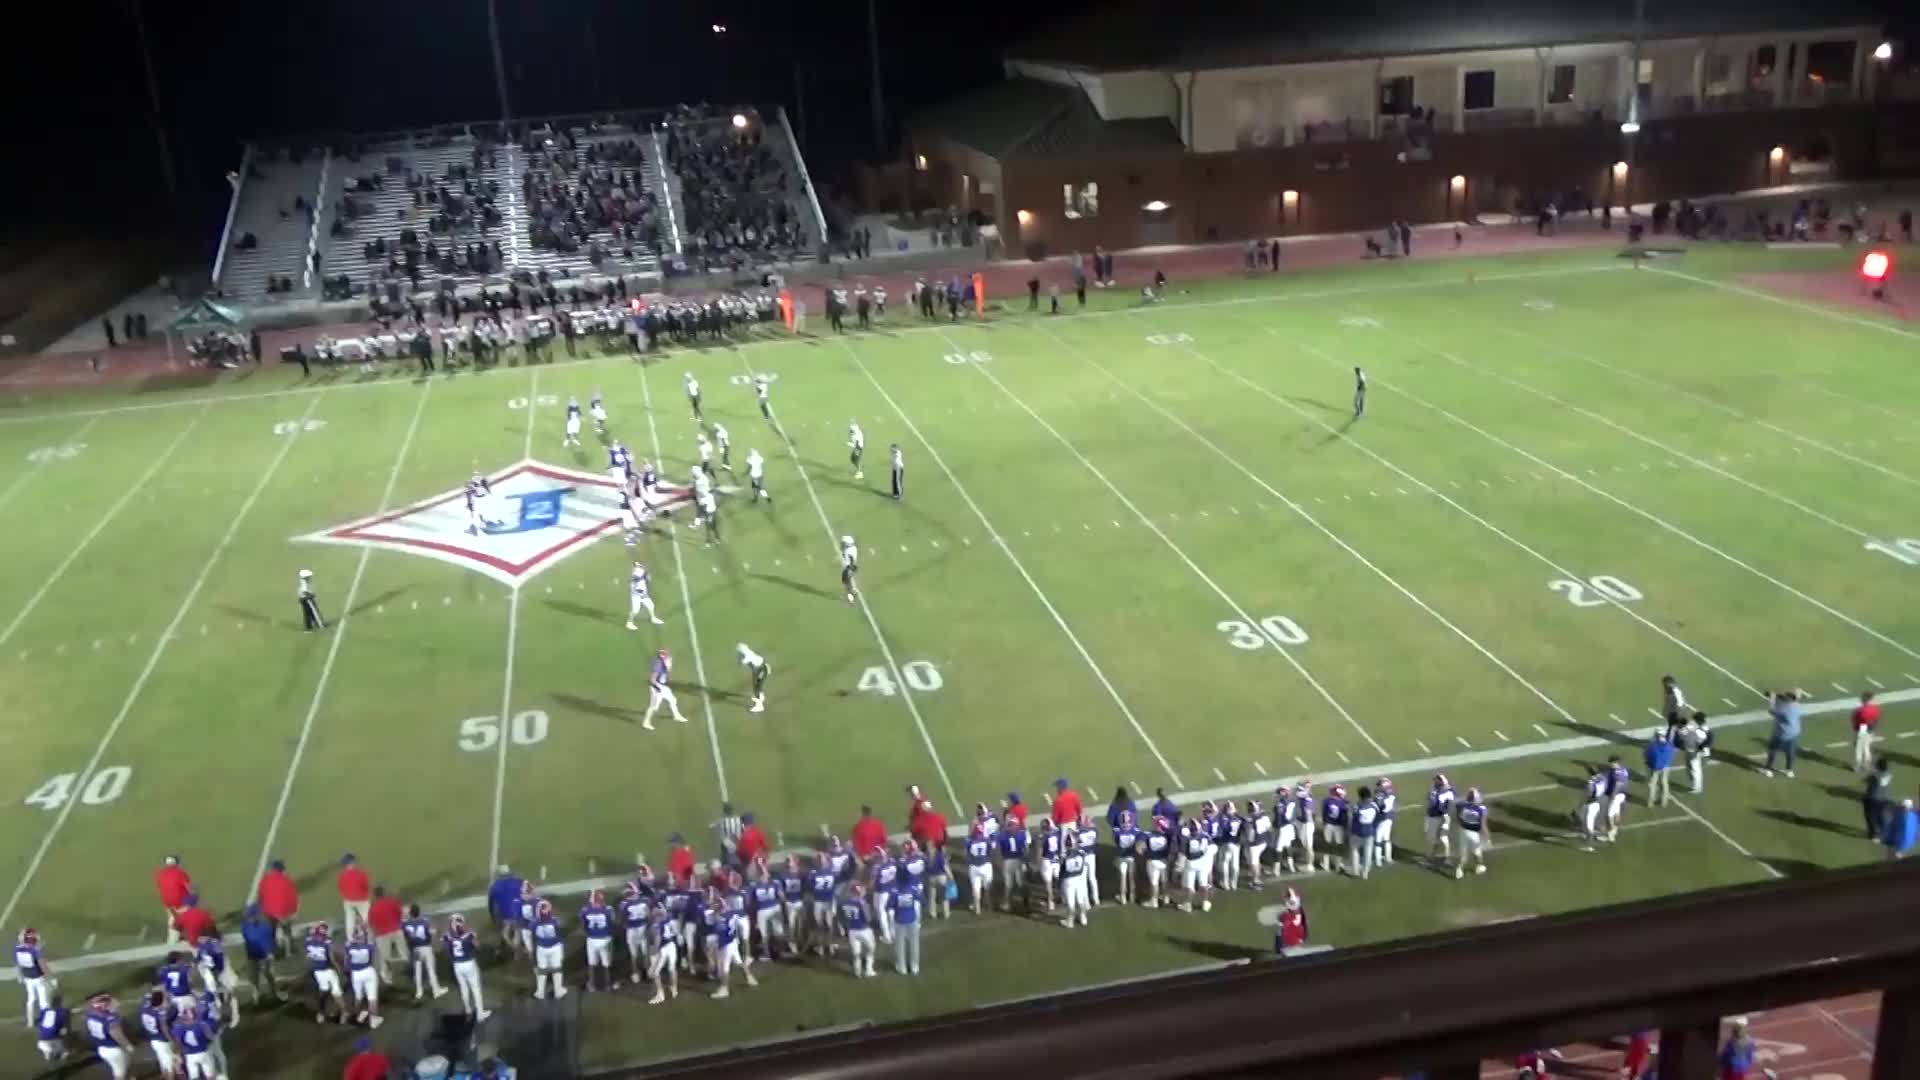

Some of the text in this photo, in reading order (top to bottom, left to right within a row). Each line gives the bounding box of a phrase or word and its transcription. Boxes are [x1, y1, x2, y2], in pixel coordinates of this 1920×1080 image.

[1548, 576, 1643, 608] 20
[1217, 616, 1309, 650] 30
[858, 661, 944, 696] 40
[458, 710, 549, 751] 50
[24, 766, 131, 810] 40
[452, 941, 465, 957] 2
[168, 972, 180, 988] 7
